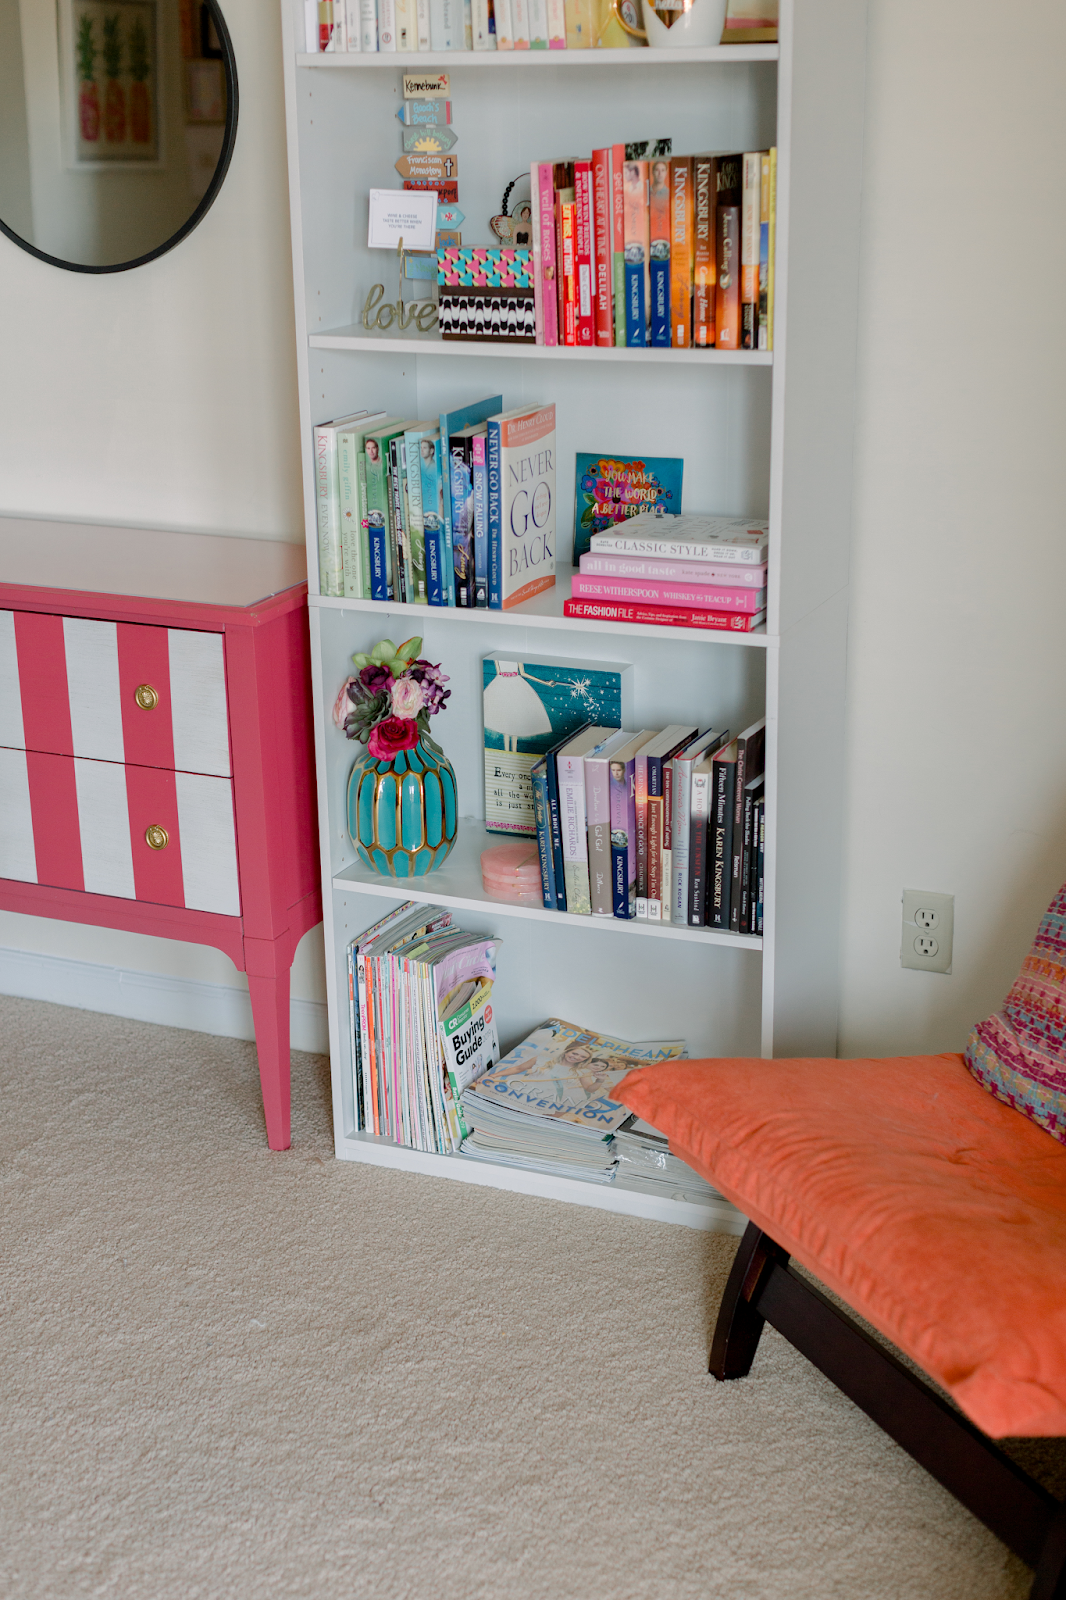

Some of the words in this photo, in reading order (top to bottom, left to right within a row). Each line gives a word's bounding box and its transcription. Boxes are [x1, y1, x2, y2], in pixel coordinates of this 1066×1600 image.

[406, 80, 445, 93] Kennebunk
[412, 114, 438, 124] Beach
[413, 102, 439, 113] Gooch's
[407, 155, 442, 164] Franciscan
[410, 166, 442, 177] Monastery
[595, 164, 604, 186] ONE
[613, 172, 623, 191] get
[542, 189, 552, 211] veil
[583, 193, 589, 204] TO
[596, 186, 605, 215] HEART
[615, 194, 624, 214] lost
[674, 167, 688, 246] KINGSBURY
[697, 163, 710, 242] KINGSBURY
[542, 214, 553, 228] of
[562, 204, 572, 218] EAT
[597, 216, 605, 226] AT
[723, 213, 732, 237] Jesus
[563, 238, 573, 255] NOT
[597, 235, 606, 256] TIME
[721, 238, 733, 271] Calling
[564, 255, 573, 276] THAT!
[598, 264, 607, 310] DELILAH
[697, 266, 708, 298] Coming
[362, 284, 439, 332] love
[700, 298, 708, 322] Home
[518, 420, 535, 432] HENRY
[536, 412, 553, 424] CLOUD
[489, 429, 498, 469] NEVER
[318, 435, 328, 500] KINGSBURY
[342, 449, 351, 474] emily
[509, 450, 553, 487] NEVER
[409, 442, 421, 509] KINGSBURY
[452, 446, 464, 513] KINGSBURY
[475, 472, 483, 501] SNOW
[489, 470, 498, 490] GO
[605, 470, 627, 482] YOU
[626, 471, 655, 484] MAKE
[343, 477, 352, 500] giffin
[425, 475, 434, 505] FOUND
[604, 486, 622, 498] THE
[624, 488, 657, 502] WORLD
[489, 492, 498, 523] BACK
[510, 482, 551, 538] GO
[592, 502, 599, 514] A
[600, 504, 637, 516] BETTER
[476, 503, 484, 538] FALLING
[342, 532, 350, 556] you're
[509, 531, 553, 577] BACK
[615, 540, 667, 553] CLASSIC
[670, 544, 708, 556] STYLE
[587, 560, 602, 571] all
[605, 561, 616, 572] in
[619, 564, 645, 574] good
[648, 565, 676, 576] taste
[580, 584, 602, 594] REESE
[603, 586, 659, 598] WITHERSPOON
[663, 592, 696, 601] WHISKEY
[704, 595, 732, 604] TEACUP
[568, 604, 583, 614] THE
[584, 605, 617, 617] FASHION
[618, 608, 633, 619] FILE
[494, 767, 515, 781] Every
[718, 767, 727, 793] Fifteen
[678, 766, 688, 810] America's
[717, 794, 726, 823] Minutes
[638, 830, 644, 839] OF
[677, 811, 686, 836] Mom
[696, 820, 702, 829] IN
[568, 816, 577, 856] RICHARDS
[716, 827, 725, 858] KAREN
[714, 860, 724, 909] KINGSBURY
[460, 951, 485, 970] Circle
[448, 1018, 458, 1030] CR
[452, 1015, 484, 1051] Buying
[550, 1020, 566, 1029] the
[456, 1036, 482, 1065] Guide
[548, 1025, 672, 1059] ADELPHEAN
[482, 1079, 613, 1124] CONVENTION
[507, 1079, 602, 1111] GRAND
